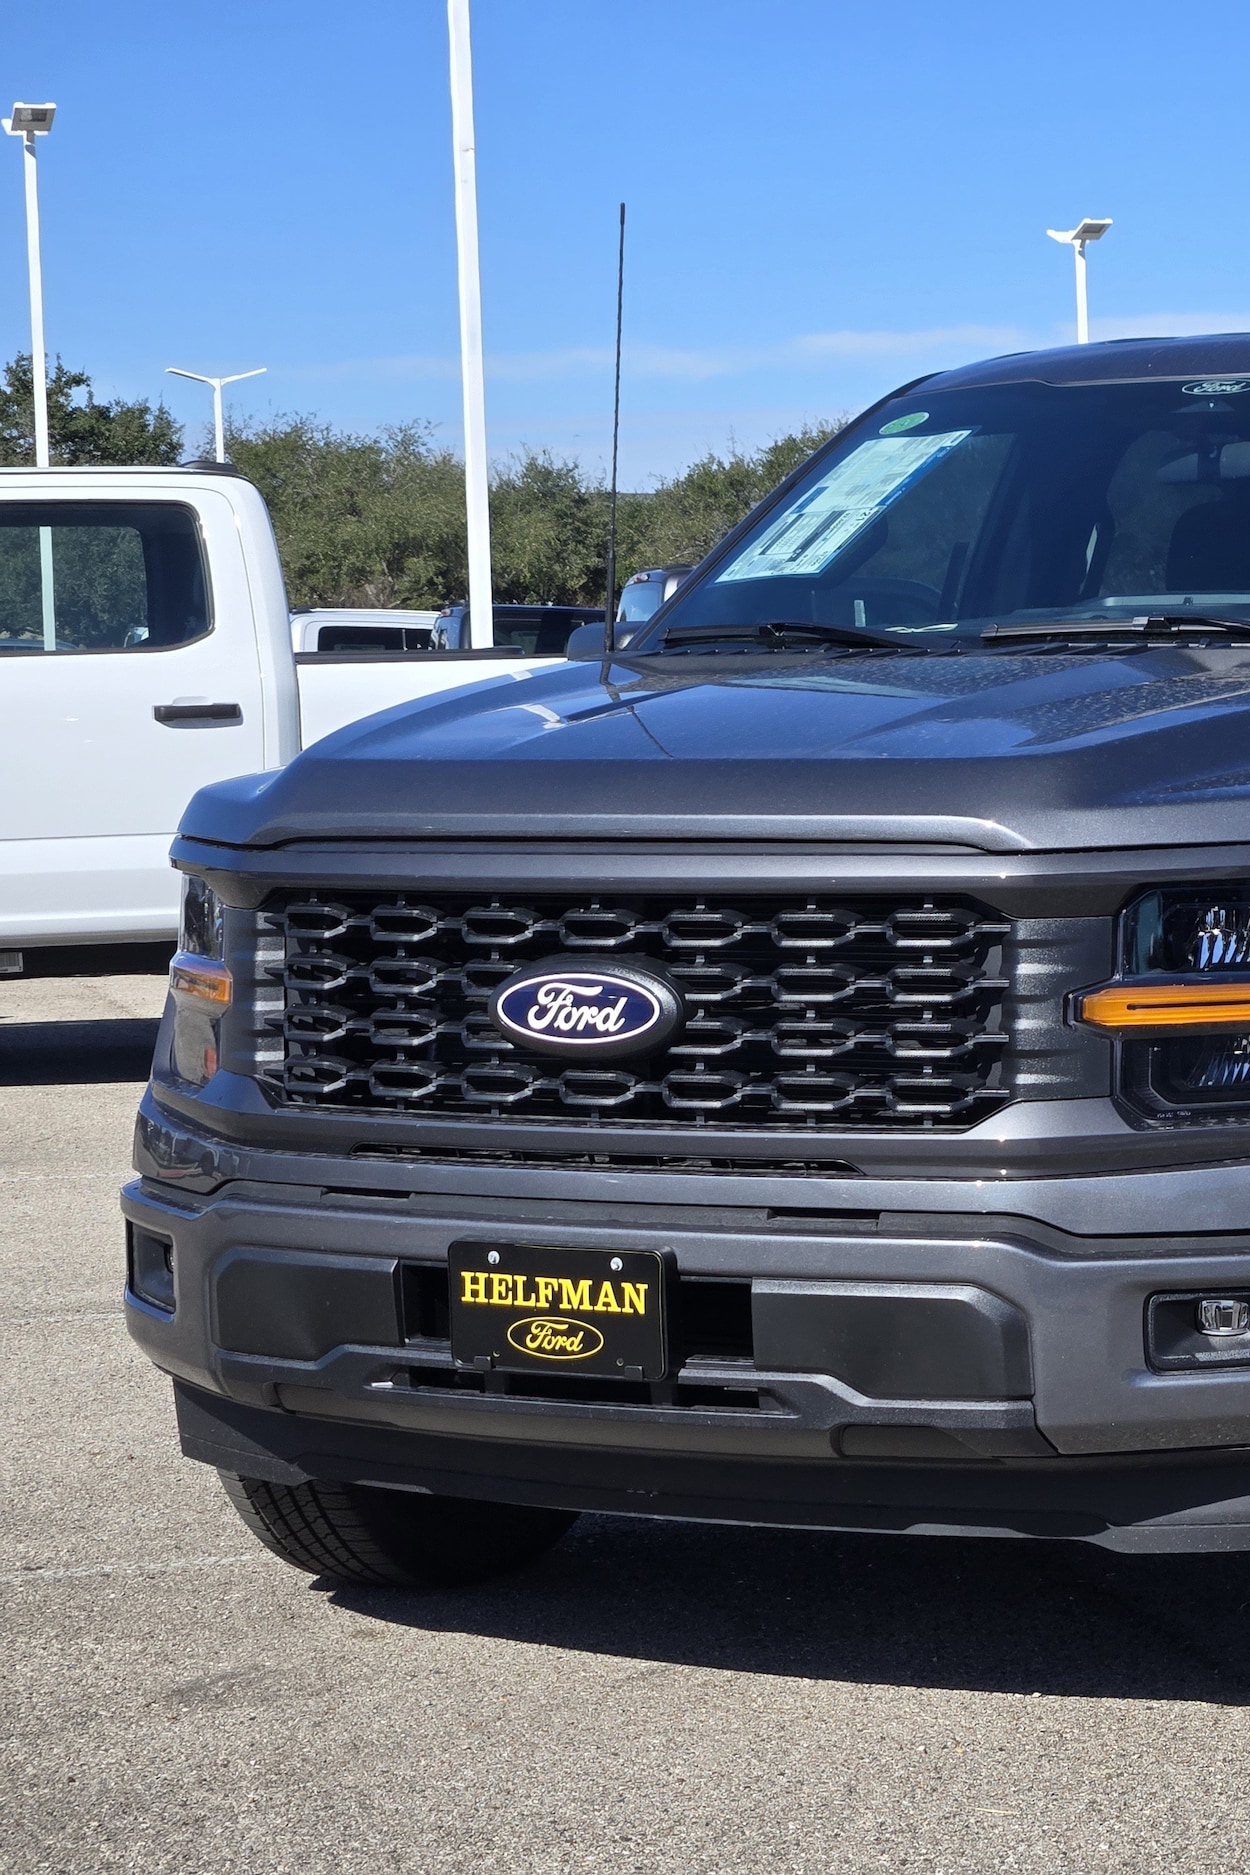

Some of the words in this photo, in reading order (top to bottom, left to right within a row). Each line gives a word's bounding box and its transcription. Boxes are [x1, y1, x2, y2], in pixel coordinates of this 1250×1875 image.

[1193, 380, 1247, 393] Ford
[527, 982, 629, 1032] Ford
[460, 1270, 649, 1315] HELFMAN
[525, 1320, 585, 1352] Ford
